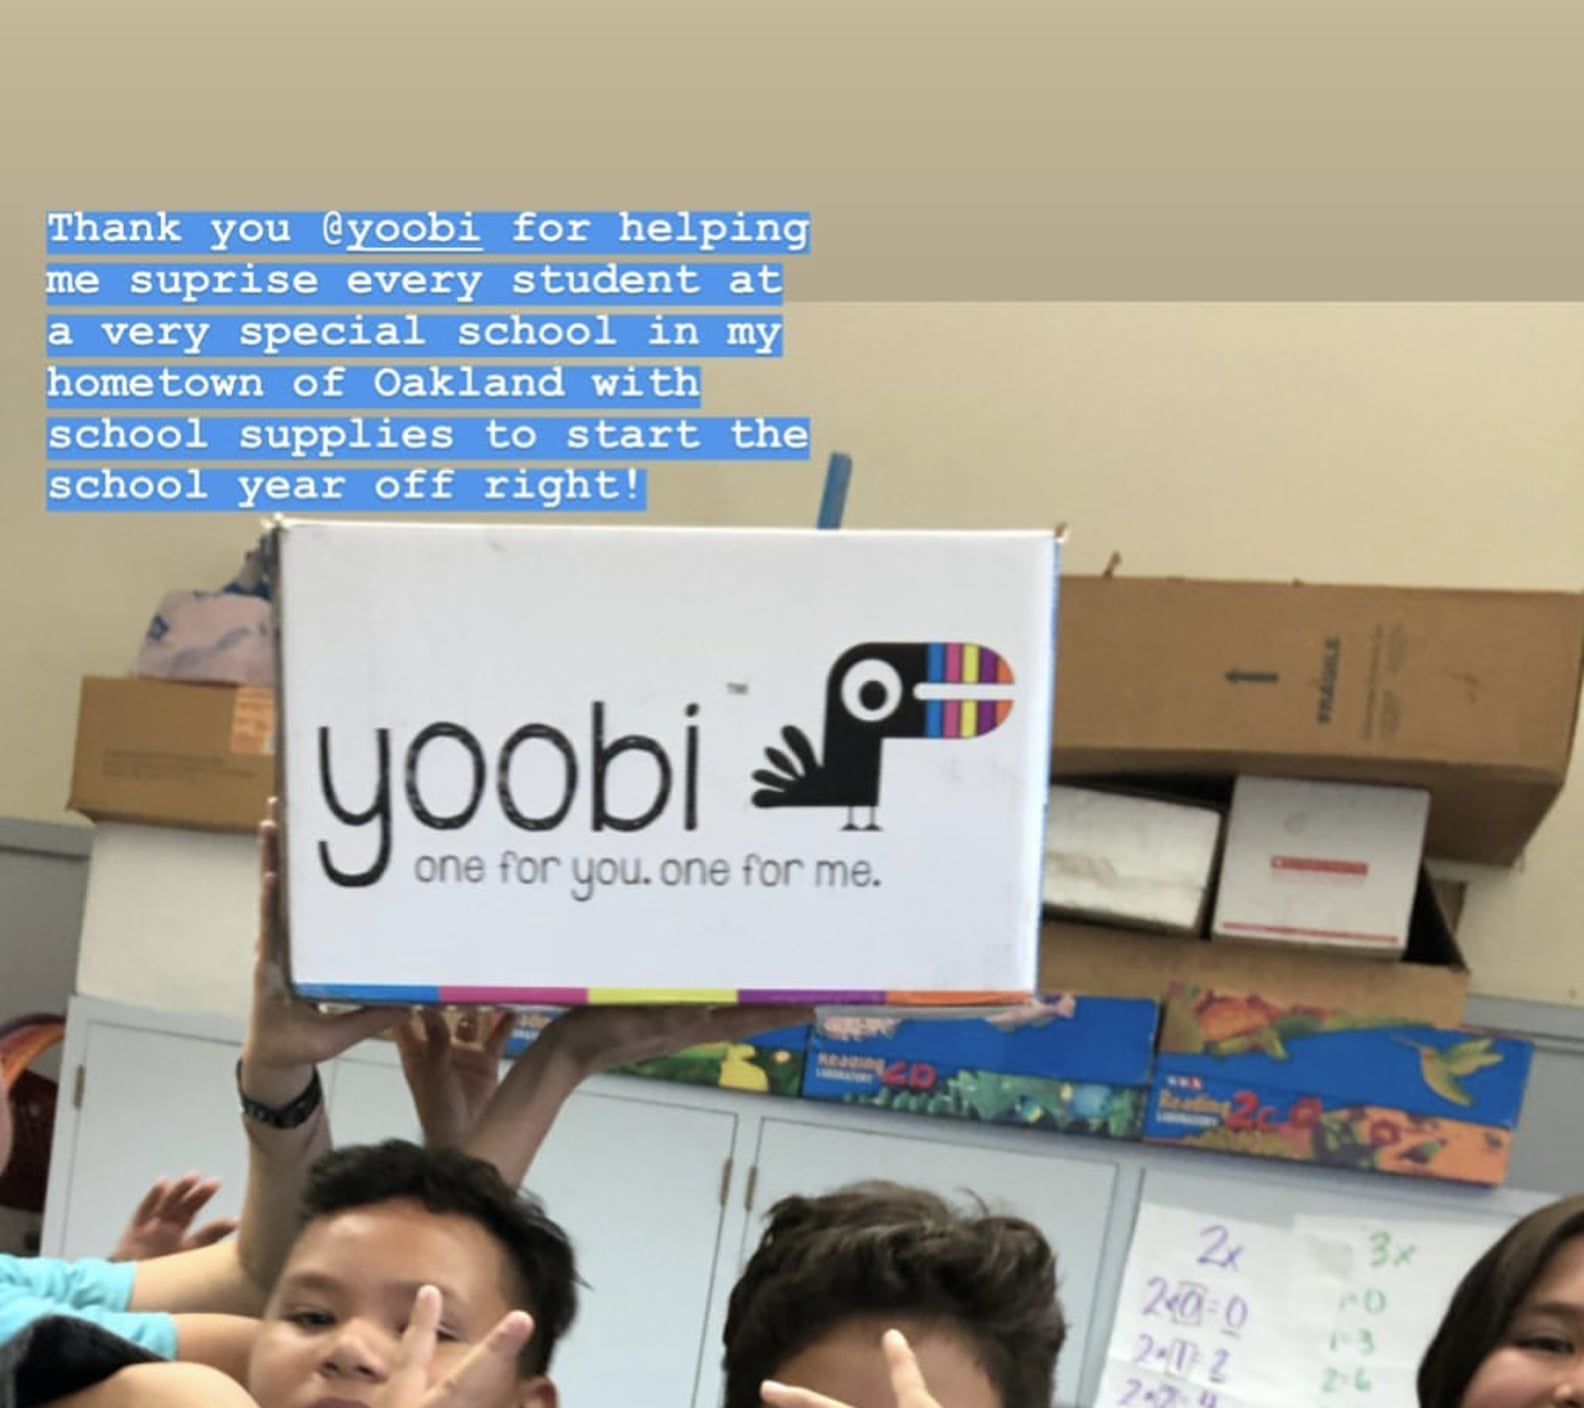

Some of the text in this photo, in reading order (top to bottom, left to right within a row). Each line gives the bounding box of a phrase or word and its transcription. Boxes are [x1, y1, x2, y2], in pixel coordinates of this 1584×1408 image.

[318, 701, 699, 888] yoobi
[418, 851, 880, 902] one for you. one for me.
